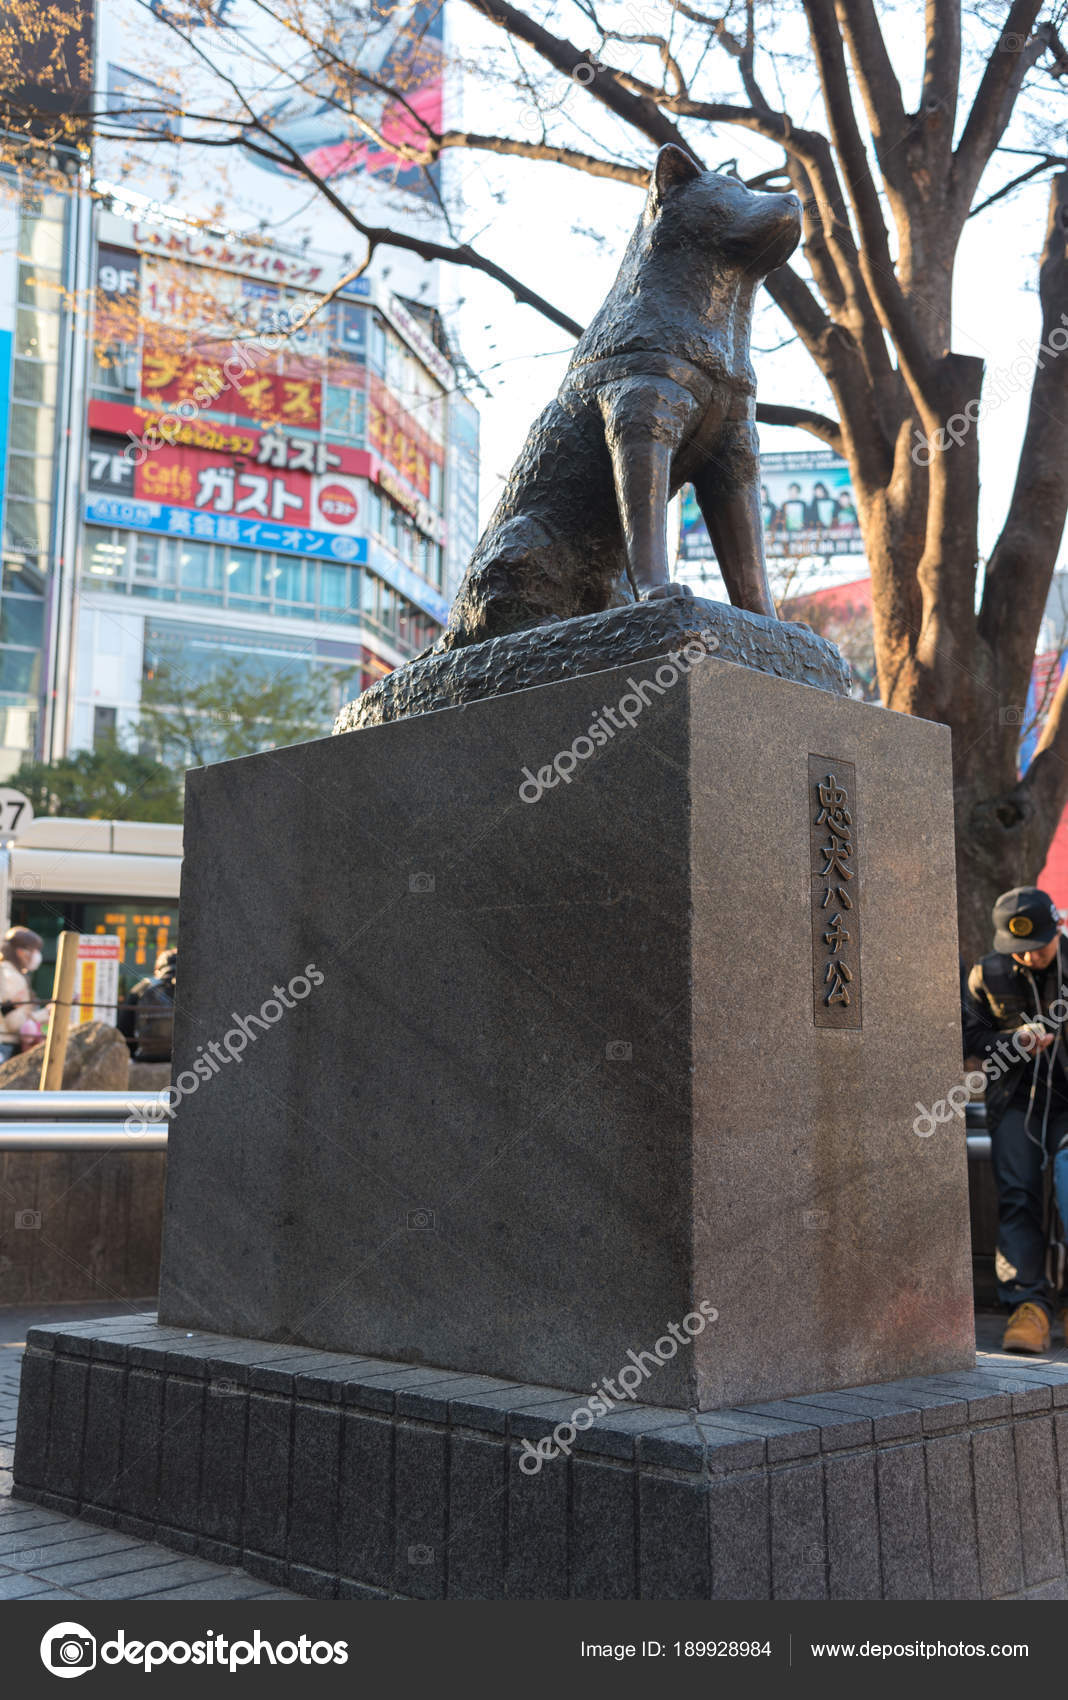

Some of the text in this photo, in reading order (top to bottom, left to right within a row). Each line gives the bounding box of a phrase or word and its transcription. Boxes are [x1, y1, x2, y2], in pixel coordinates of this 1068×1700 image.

[100, 265, 136, 295] 9F
[90, 451, 132, 483] 7F
[257, 434, 341, 474] ガスト
[142, 461, 192, 487] Café
[195, 467, 304, 520] ガスト
[168, 509, 325, 551] 英会話イーオン
[0, 801, 25, 831] 7
[815, 775, 854, 1008] 忠犬ハチ公
